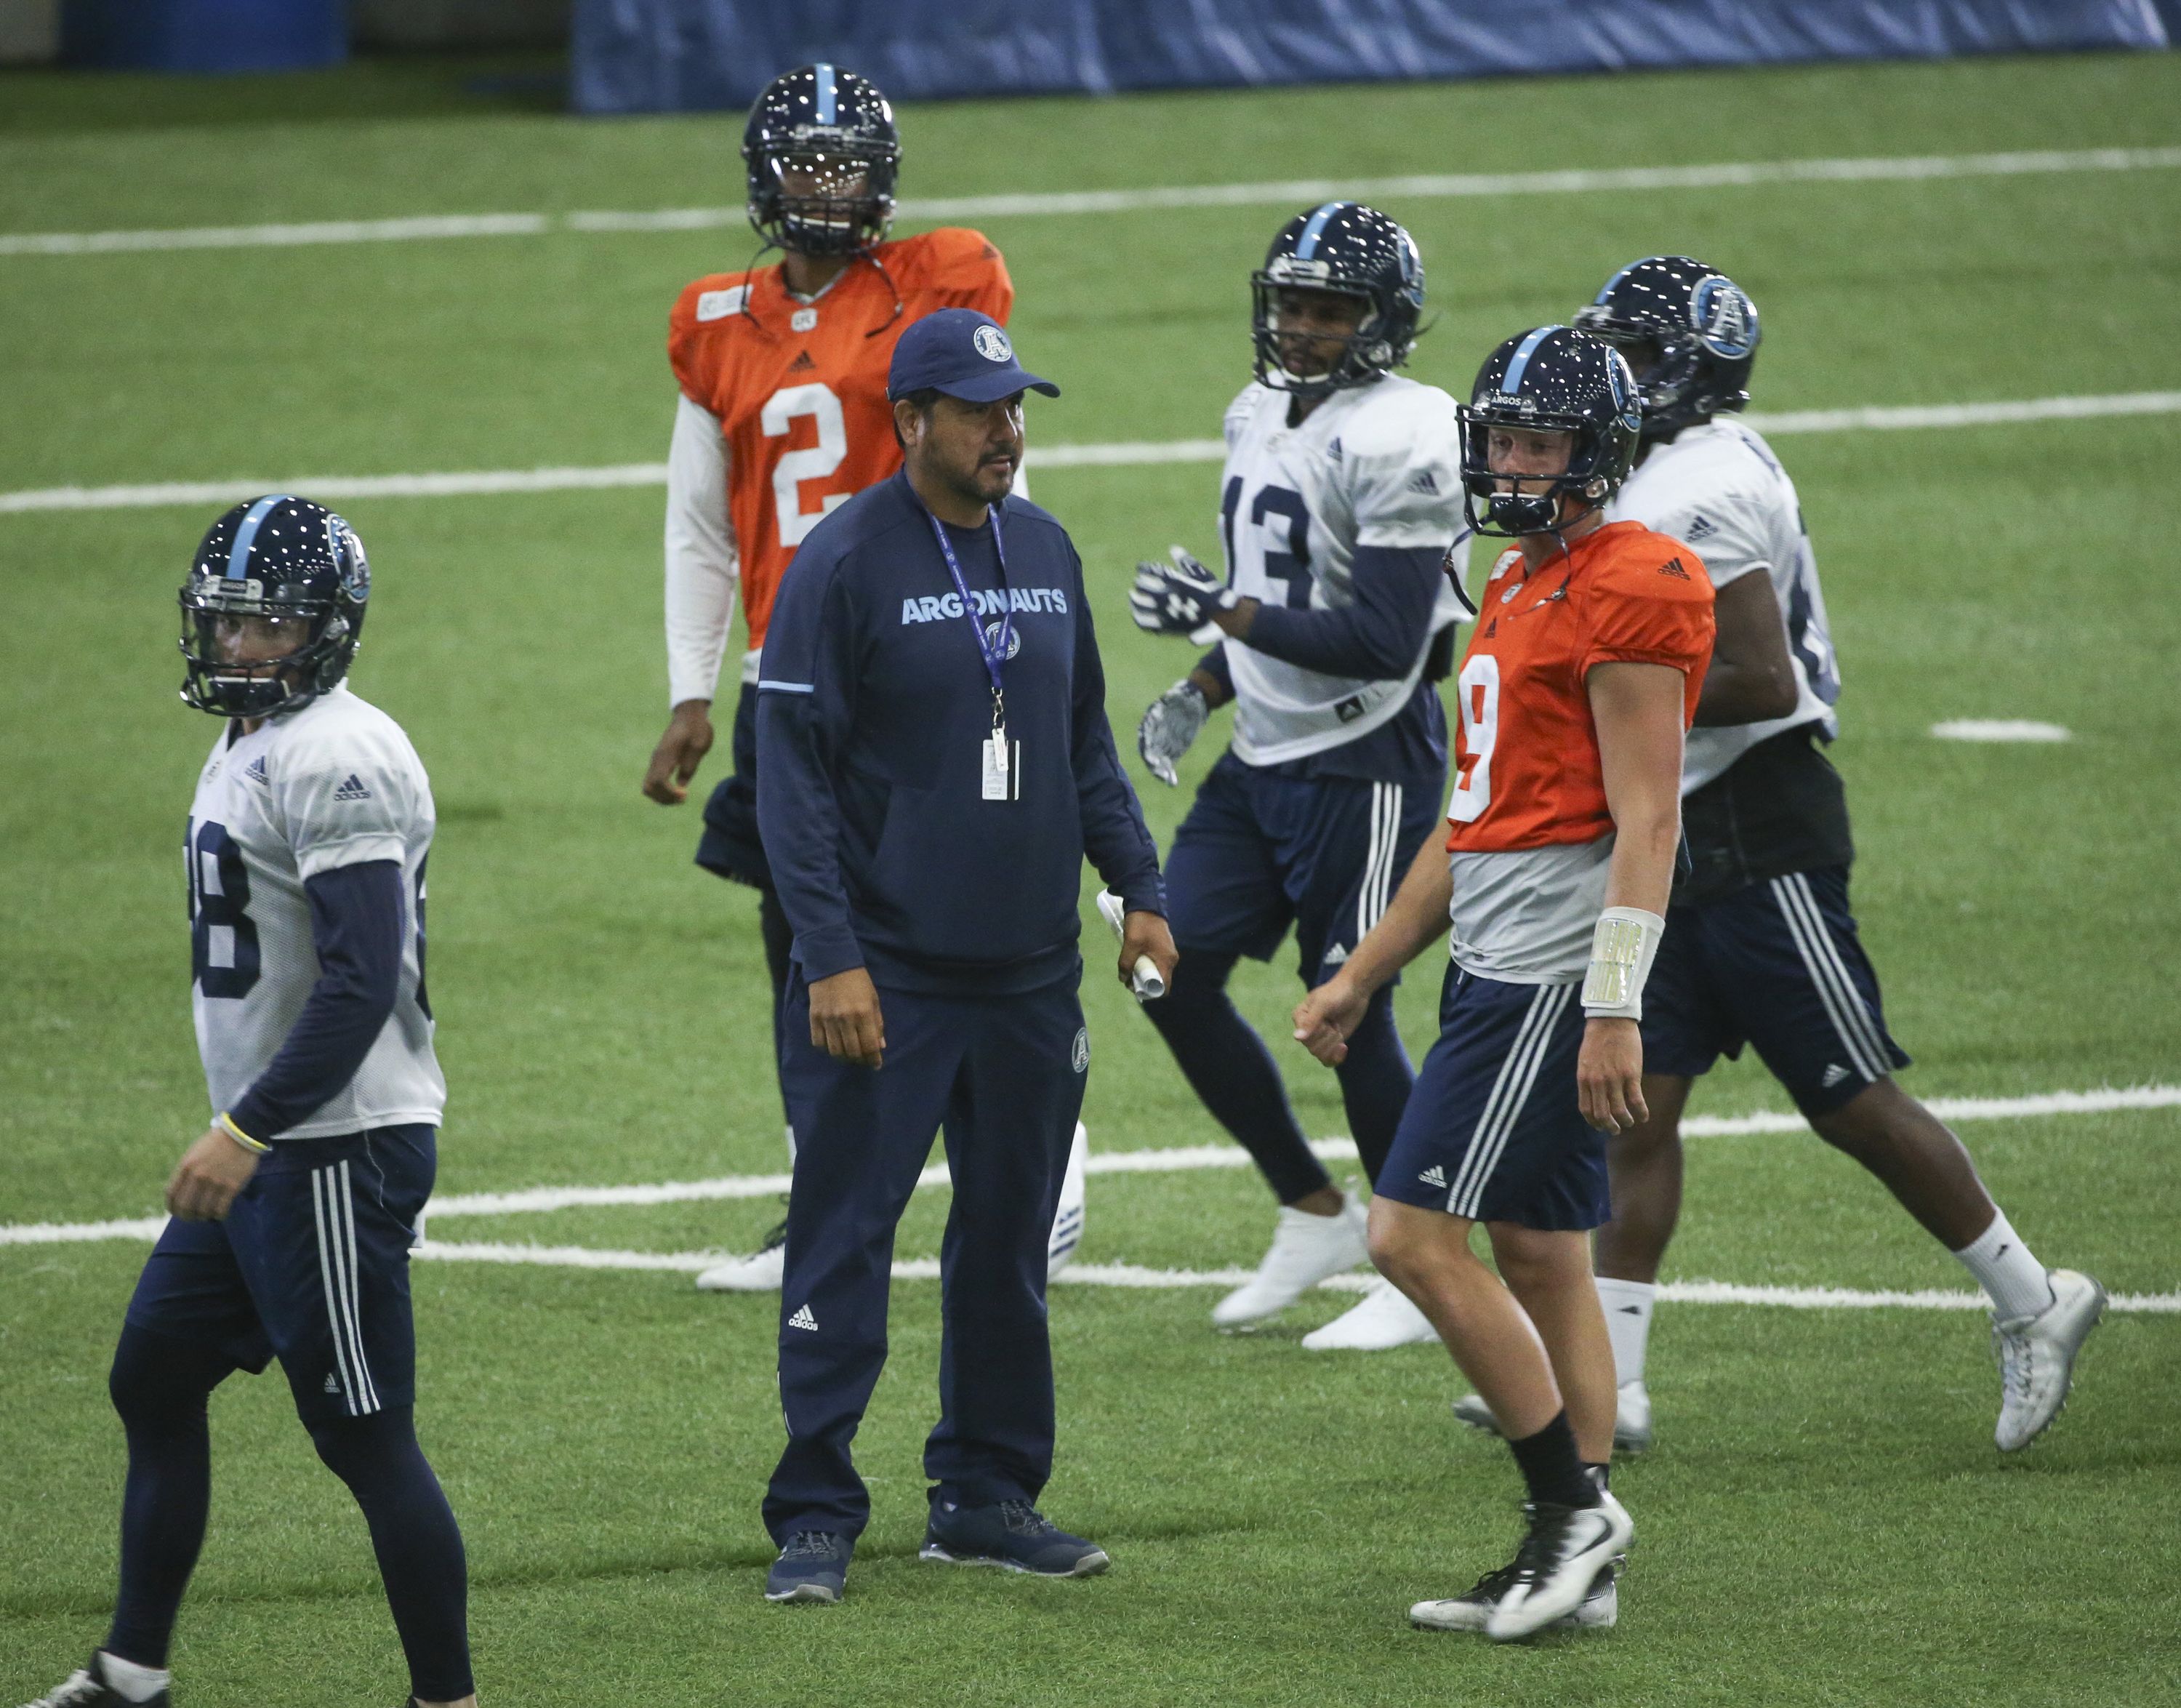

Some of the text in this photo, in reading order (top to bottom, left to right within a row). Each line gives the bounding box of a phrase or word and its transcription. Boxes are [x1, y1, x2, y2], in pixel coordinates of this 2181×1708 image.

[1491, 396, 1522, 406] ARGOS
[760, 382, 852, 547] 2
[901, 588, 1067, 625] ARGONAUTS
[1447, 654, 1500, 822] 9
[788, 1318, 819, 1331] adidas
